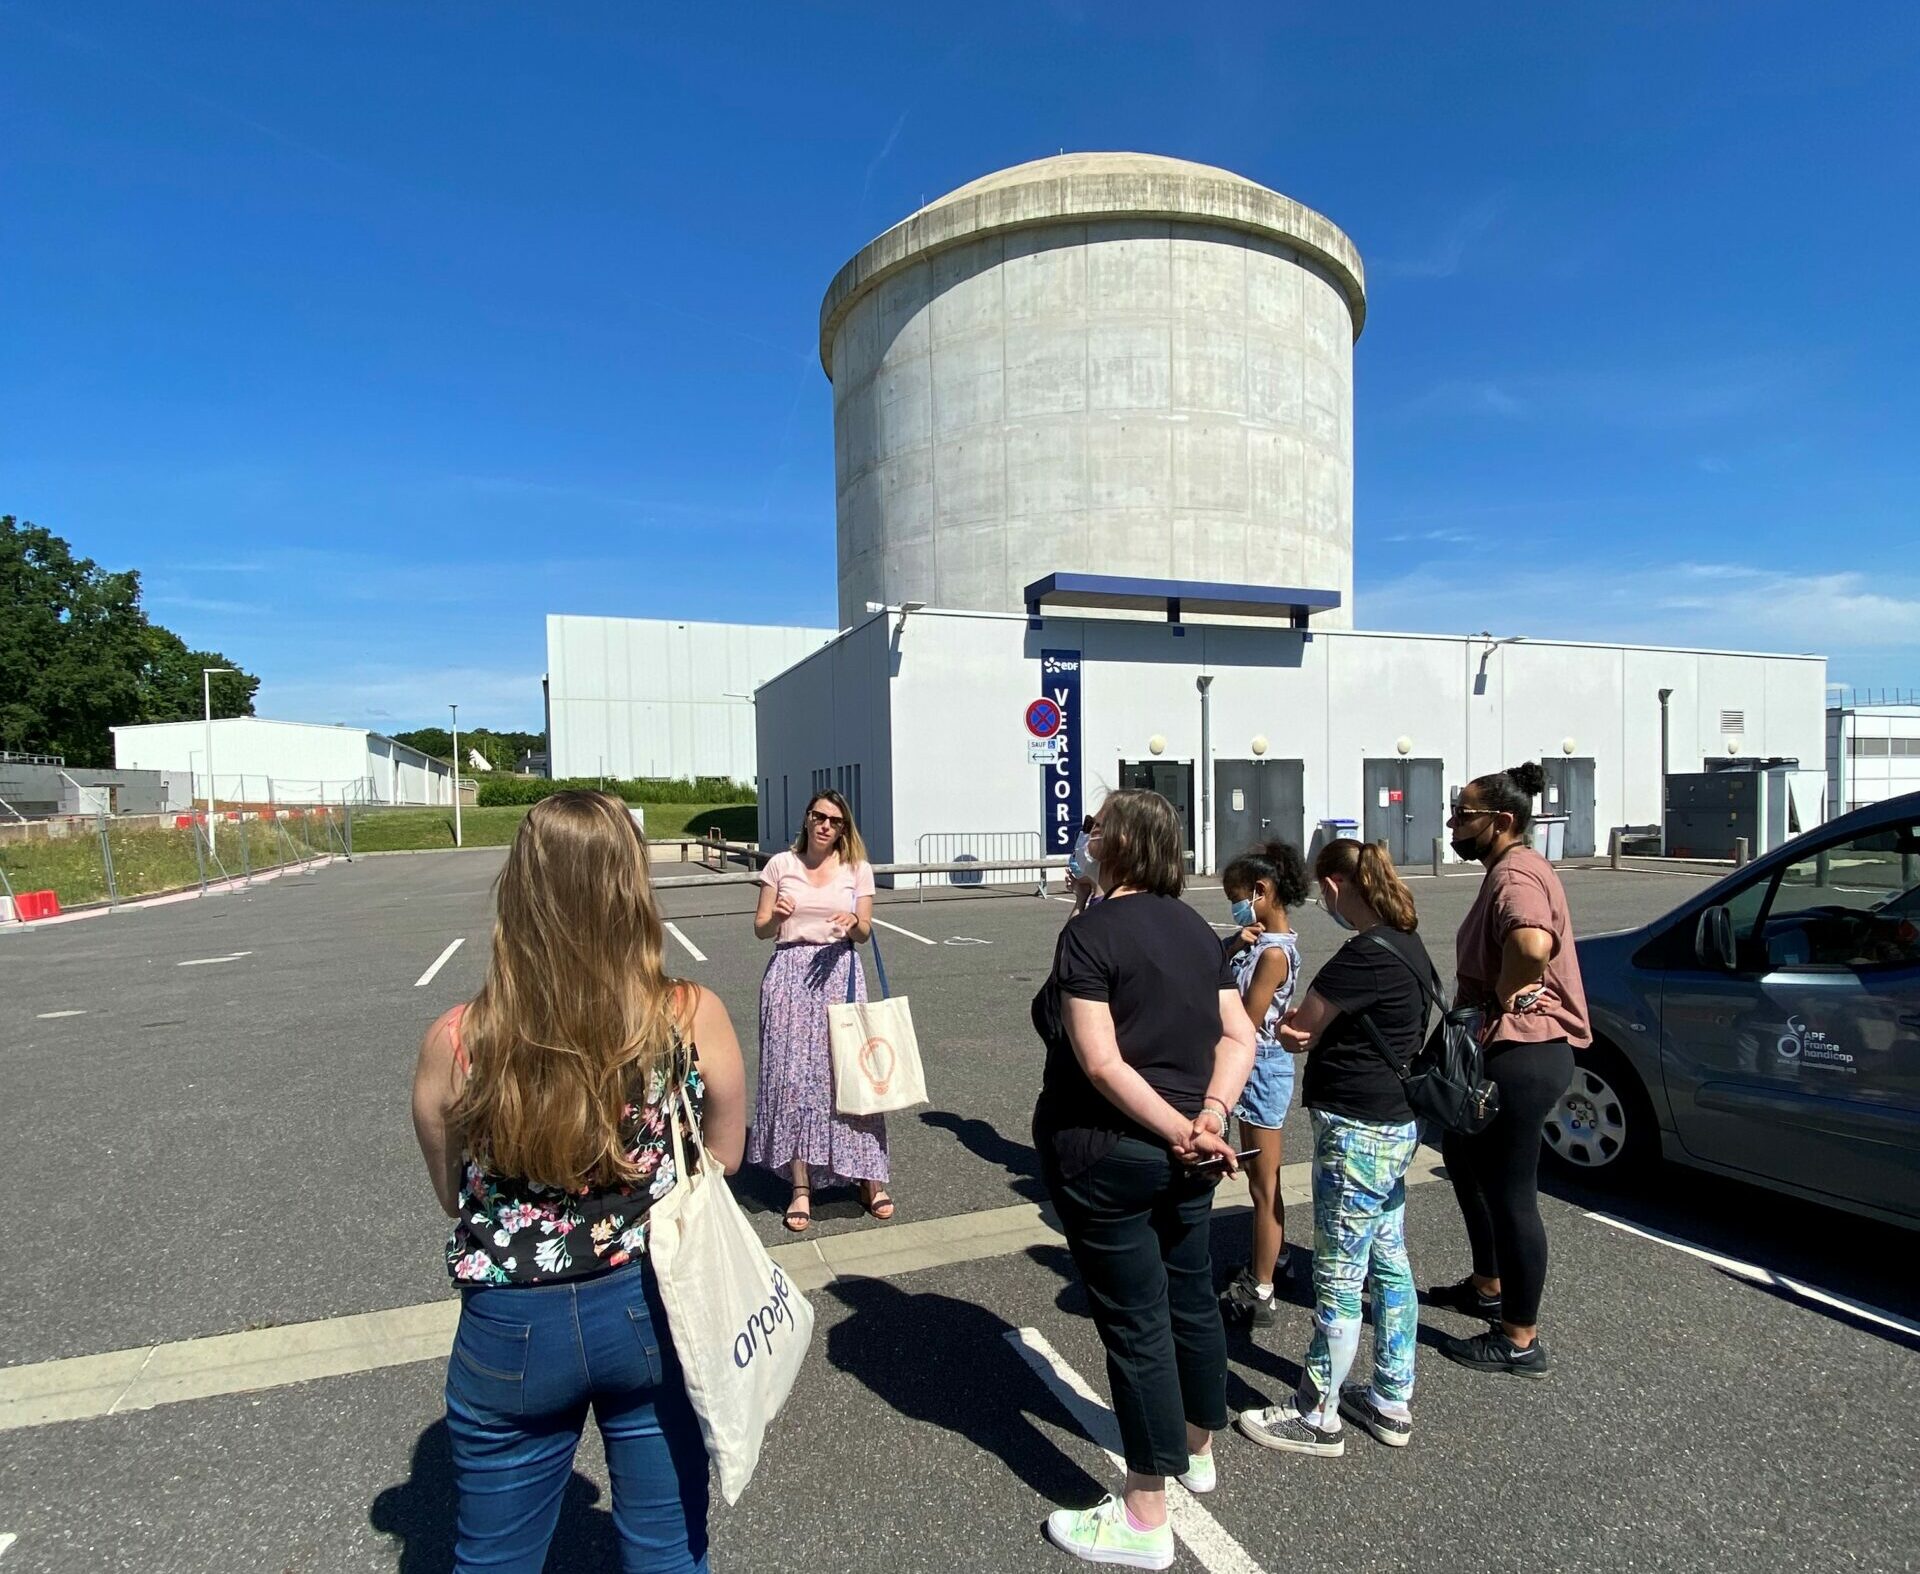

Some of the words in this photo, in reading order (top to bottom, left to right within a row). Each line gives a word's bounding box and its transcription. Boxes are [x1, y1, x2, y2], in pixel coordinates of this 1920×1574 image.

[1054, 688, 1071, 845] VERCORS
[1804, 1032, 1826, 1041] APF
[1804, 1039, 1840, 1052] France
[1804, 1050, 1854, 1063] handicap
